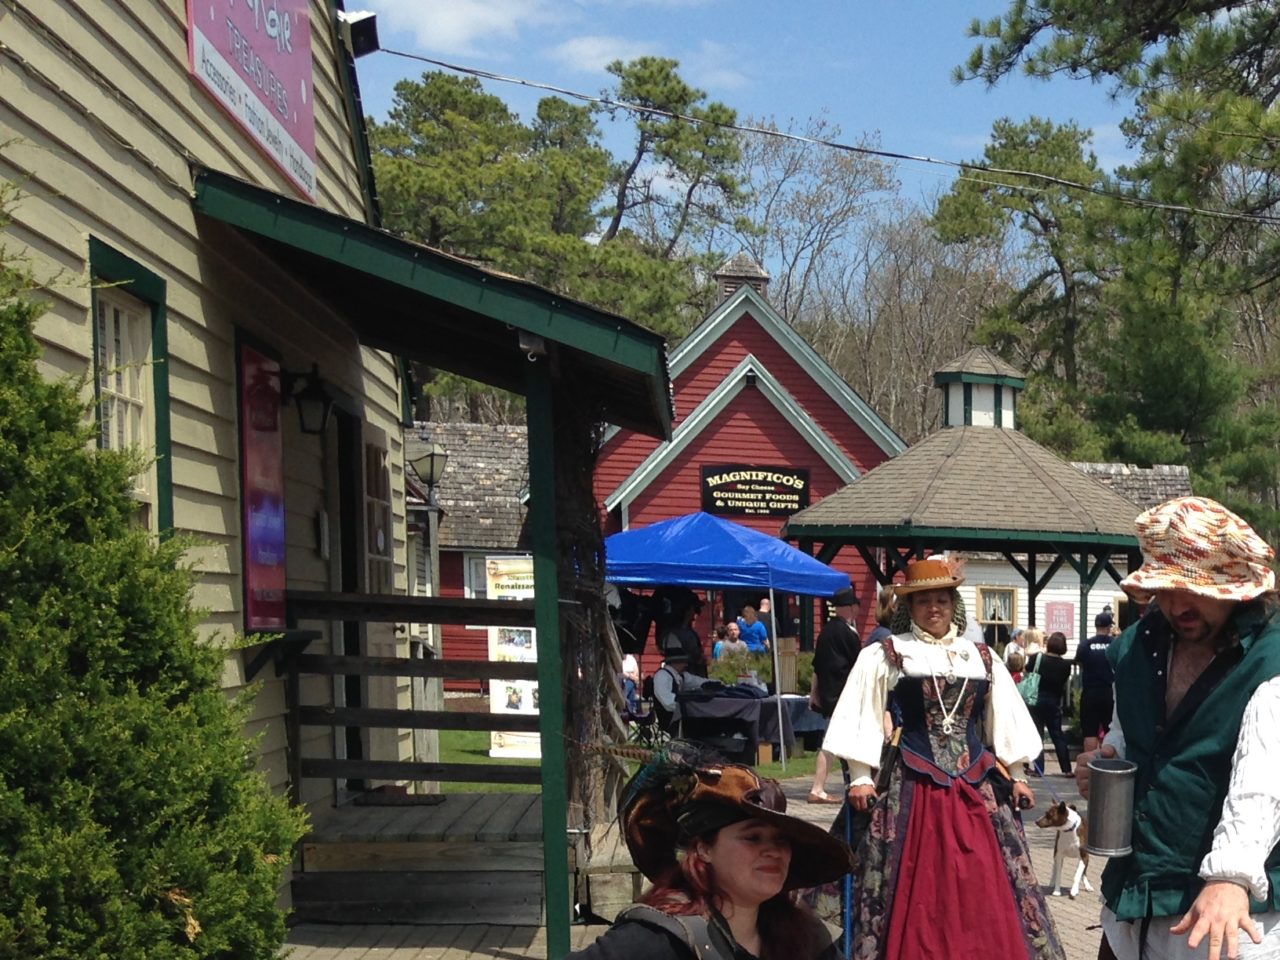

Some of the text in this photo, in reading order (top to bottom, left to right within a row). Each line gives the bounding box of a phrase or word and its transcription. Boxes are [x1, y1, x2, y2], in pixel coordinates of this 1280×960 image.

[226, 17, 289, 119] TREASURES
[201, 44, 237, 106] Accessories
[289, 144, 313, 194] Handbags
[706, 471, 804, 489] MAGNIFICO'S
[713, 491, 799, 501] GOURMET FOODS
[727, 500, 767, 508] UNIQUE
[769, 501, 799, 509] GIFTS
